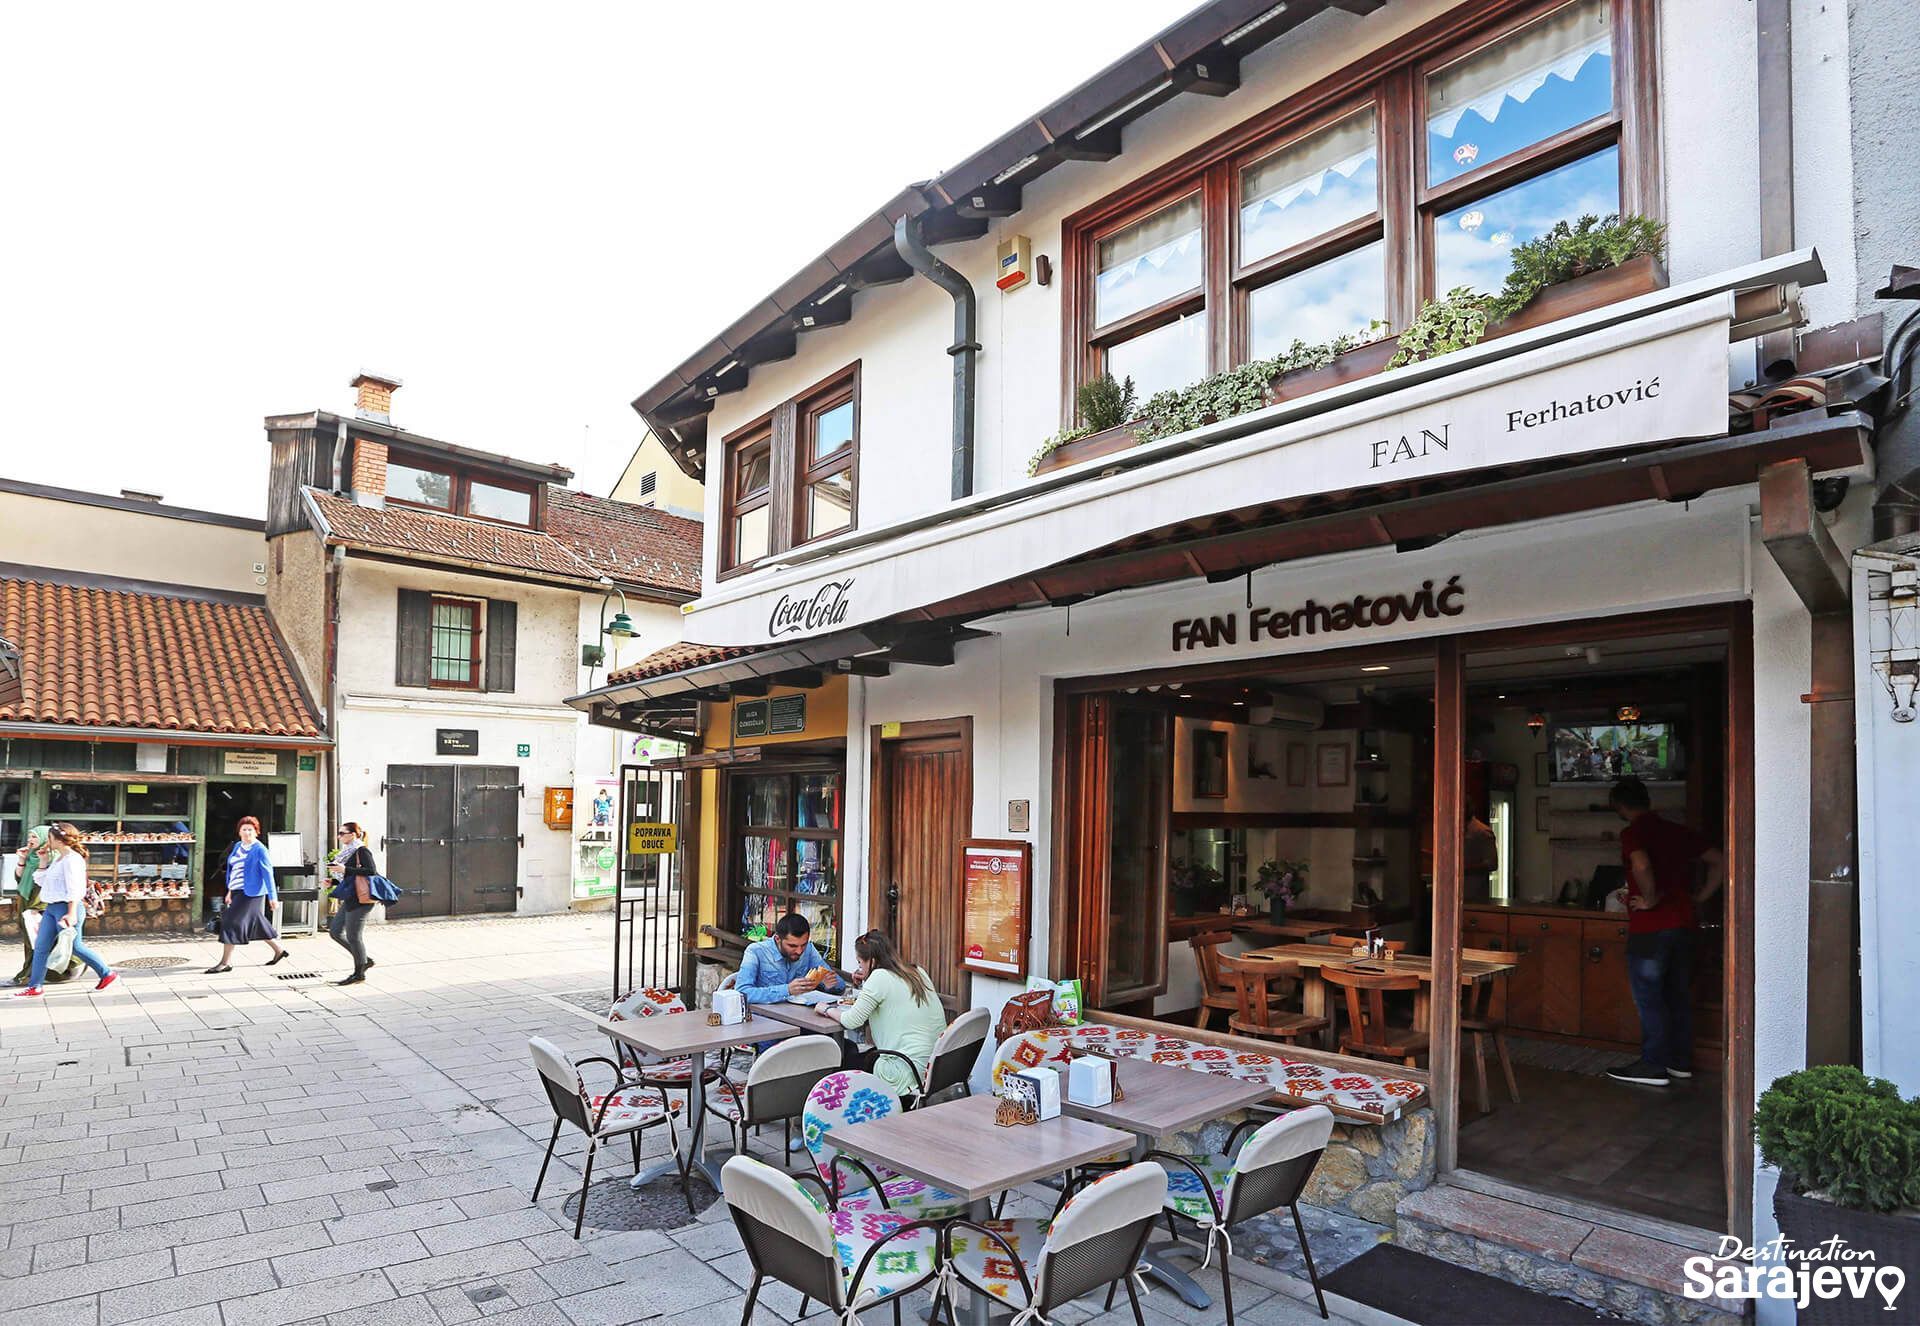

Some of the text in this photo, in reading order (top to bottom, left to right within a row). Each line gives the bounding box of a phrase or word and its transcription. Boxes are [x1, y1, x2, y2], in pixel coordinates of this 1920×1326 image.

[1369, 376, 1661, 469] FAN Ferhatović
[1172, 575, 1464, 651] FAN Ferhatović
[634, 827, 672, 838] POPRAVKA
